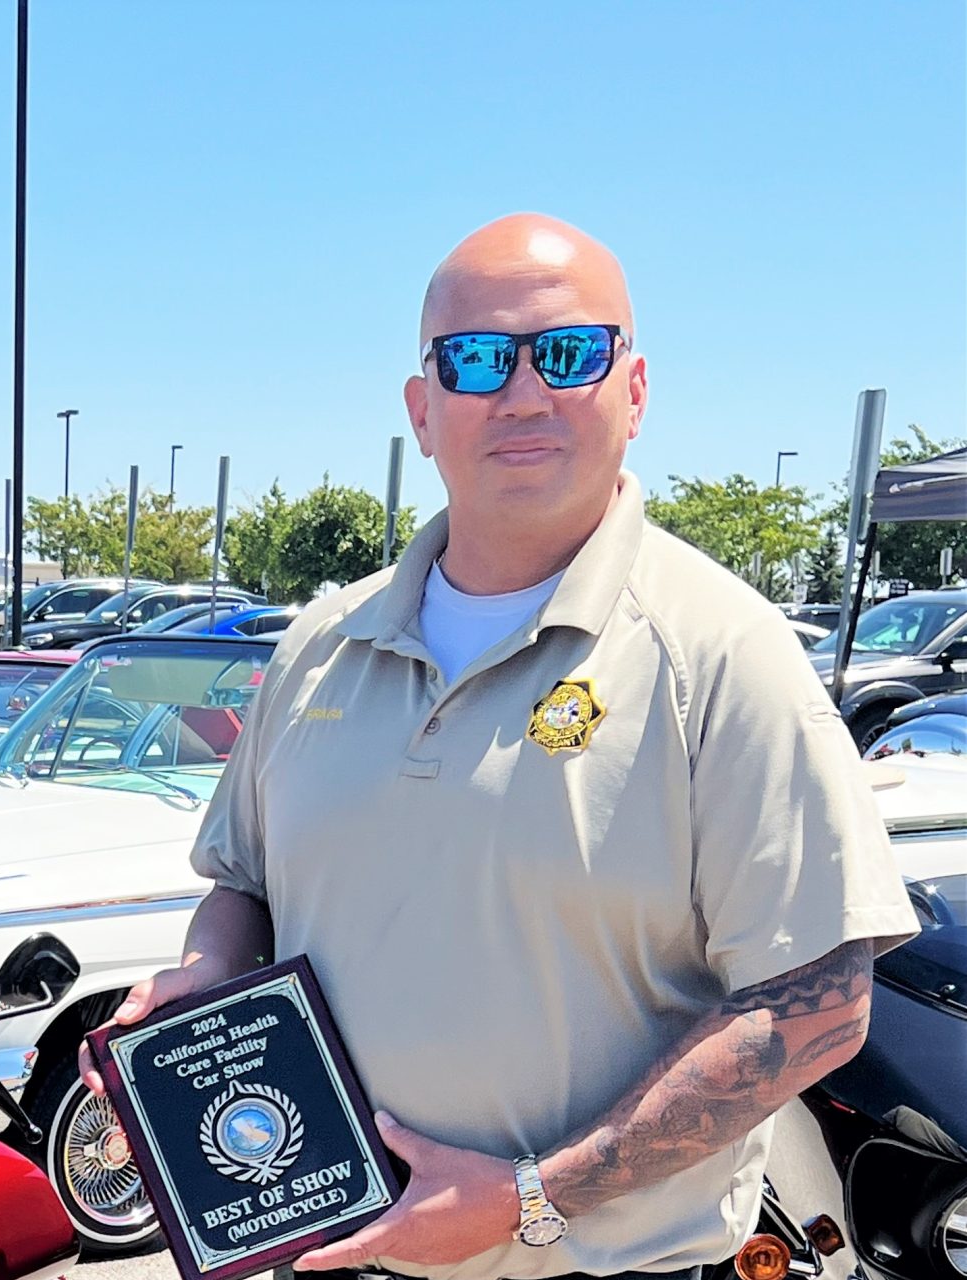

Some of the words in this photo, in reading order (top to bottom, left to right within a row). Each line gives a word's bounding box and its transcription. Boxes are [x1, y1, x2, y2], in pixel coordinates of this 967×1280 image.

[153, 1034, 226, 1068] California
[227, 1013, 280, 1041] Health
[191, 1013, 228, 1036] 2024
[176, 1058, 212, 1077] Care
[213, 1036, 268, 1064] Facility
[192, 1072, 220, 1089] Car
[223, 1056, 264, 1079] Show
[201, 1196, 254, 1229] BEST
[258, 1184, 285, 1208] OF
[290, 1160, 352, 1197] SHOW
[227, 1187, 348, 1243] (MOTORCYCLE)
